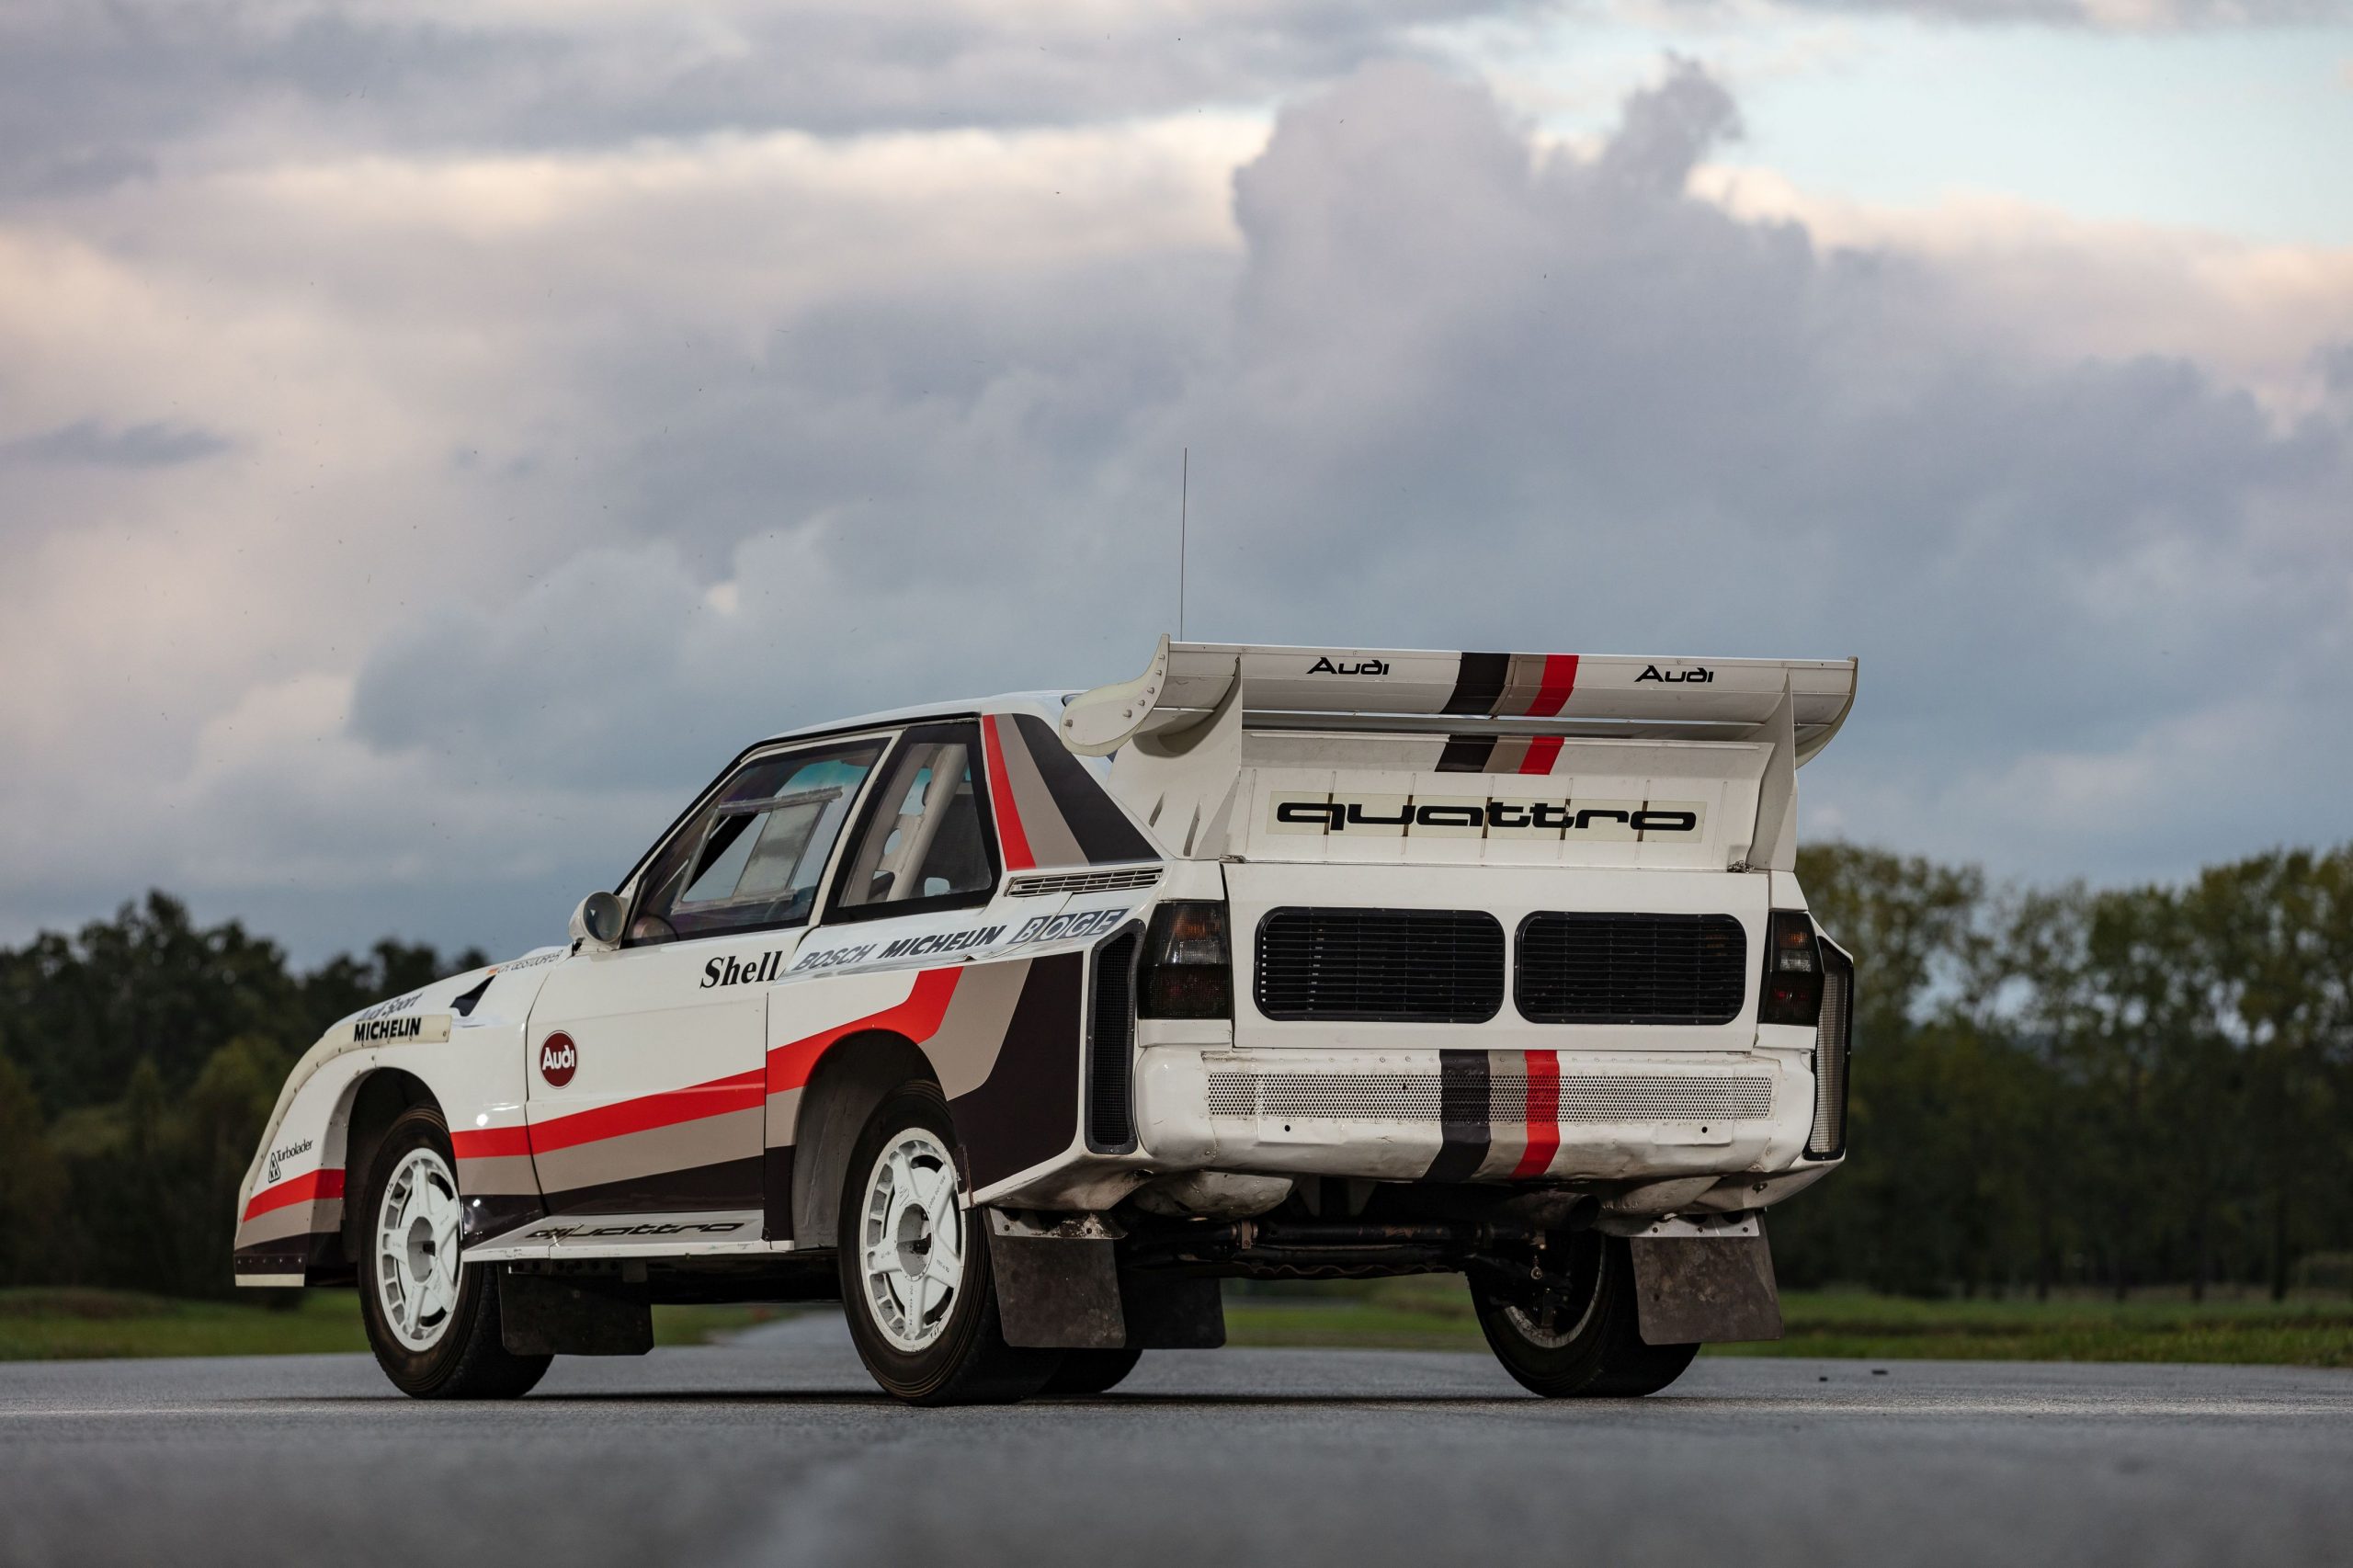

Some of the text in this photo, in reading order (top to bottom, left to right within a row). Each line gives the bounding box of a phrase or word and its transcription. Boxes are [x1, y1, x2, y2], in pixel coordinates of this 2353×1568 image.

[1306, 656, 1390, 676] Audi
[1634, 665, 1714, 684] Audi
[1277, 801, 1697, 832] quattro
[791, 909, 1128, 971] BOSCH MICHELIN BOGE
[699, 950, 783, 990] Shell
[354, 1017, 422, 1042] MICHELIN
[542, 1044, 575, 1071] Audi
[277, 1139, 313, 1163] Turbolader
